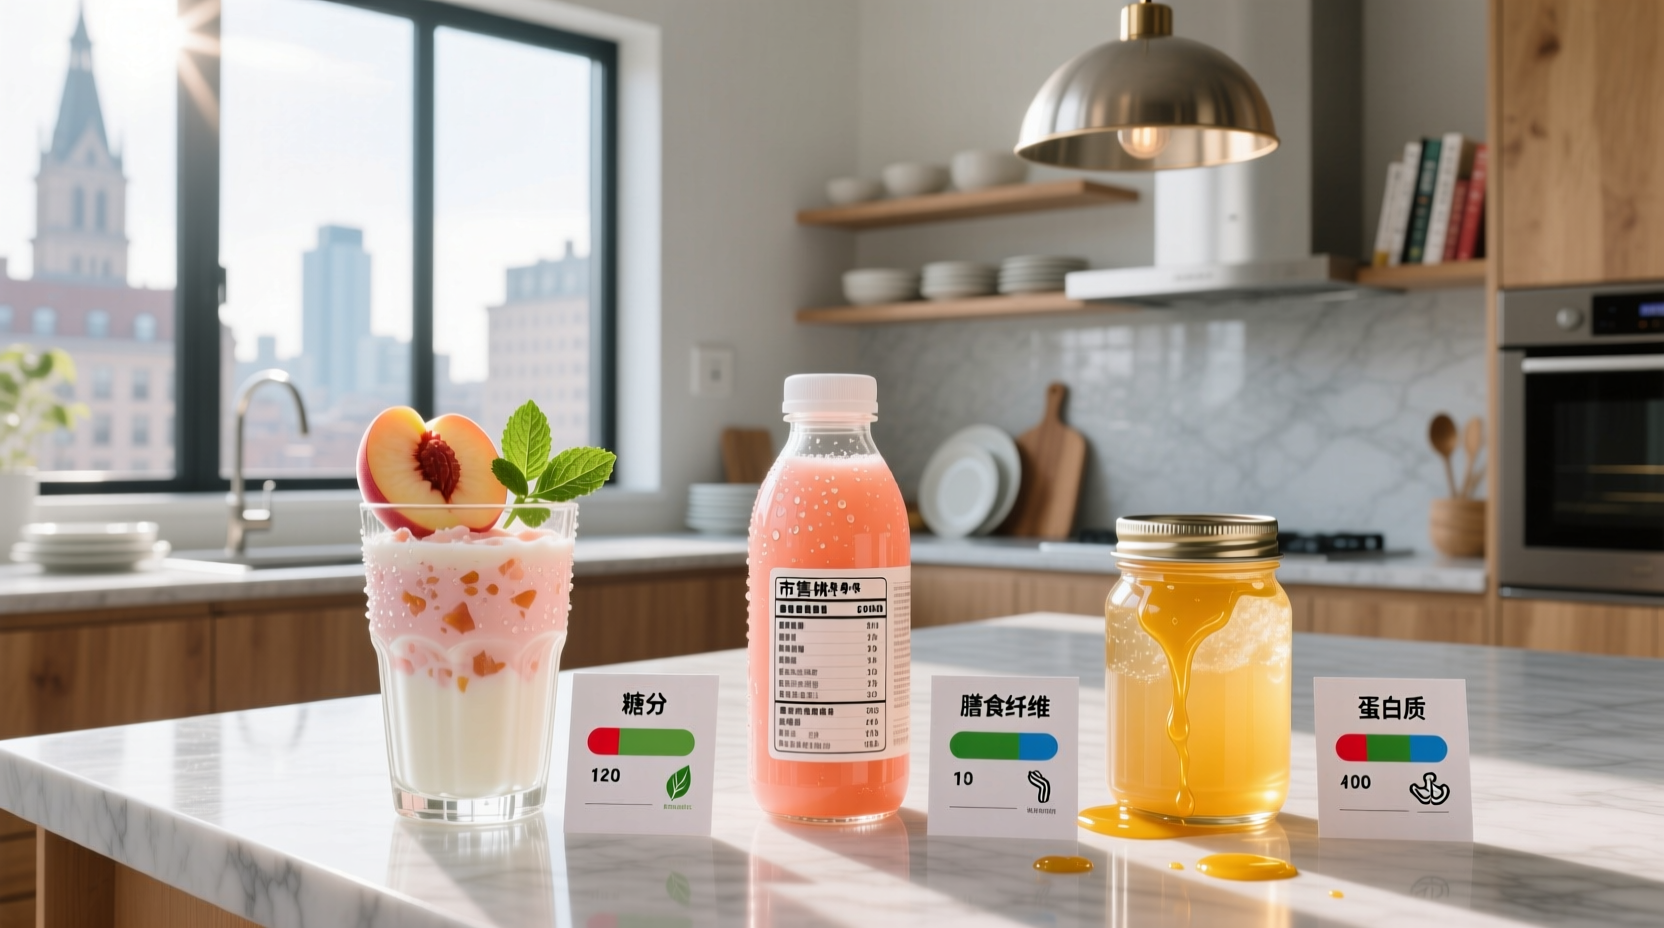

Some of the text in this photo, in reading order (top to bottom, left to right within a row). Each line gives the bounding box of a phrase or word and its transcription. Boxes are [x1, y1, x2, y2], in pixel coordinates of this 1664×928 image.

[621, 691, 667, 715] 糖分
[960, 694, 1051, 718] 膳食纤维
[1358, 696, 1426, 720] 蛋白质
[591, 768, 621, 783] 120
[953, 771, 974, 786] 10
